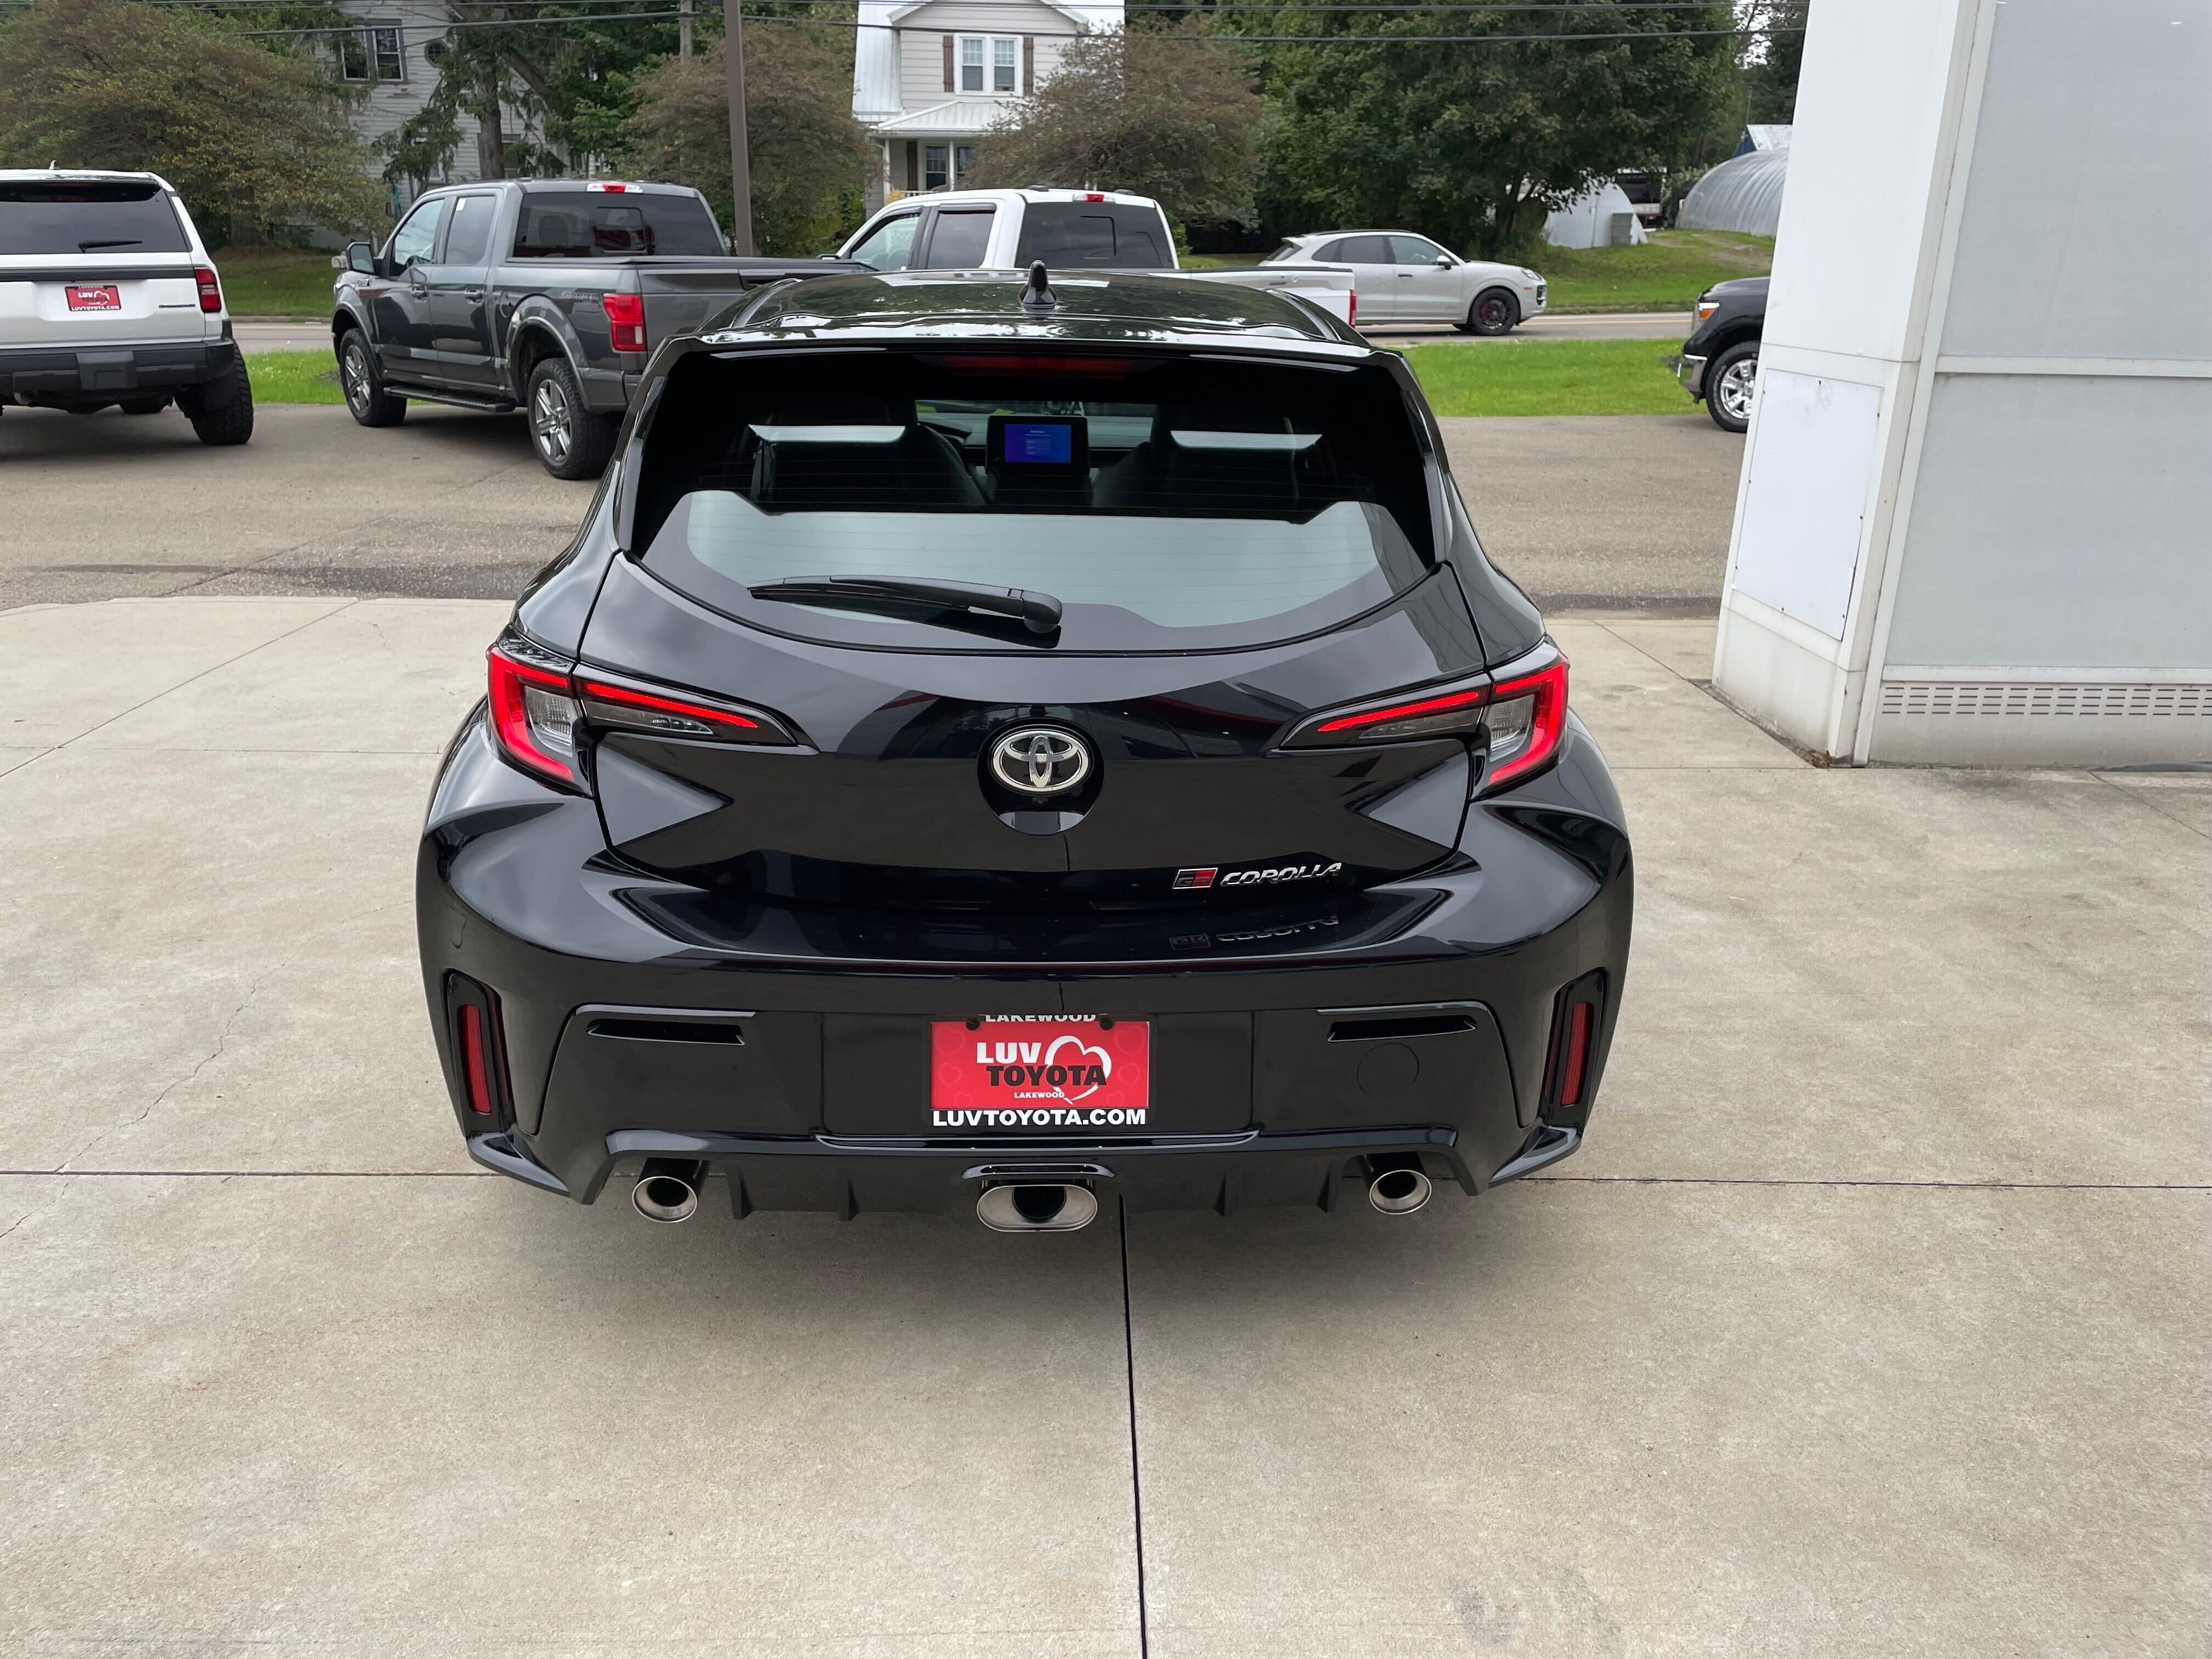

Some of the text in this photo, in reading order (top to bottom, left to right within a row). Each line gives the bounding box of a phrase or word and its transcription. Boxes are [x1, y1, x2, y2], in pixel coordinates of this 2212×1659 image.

[1220, 863, 1342, 885] COROLLA
[977, 1042, 1042, 1064] LUV
[986, 1065, 1106, 1086] TOYOTA
[933, 1109, 1146, 1126] LUVTOYOTA.COM
